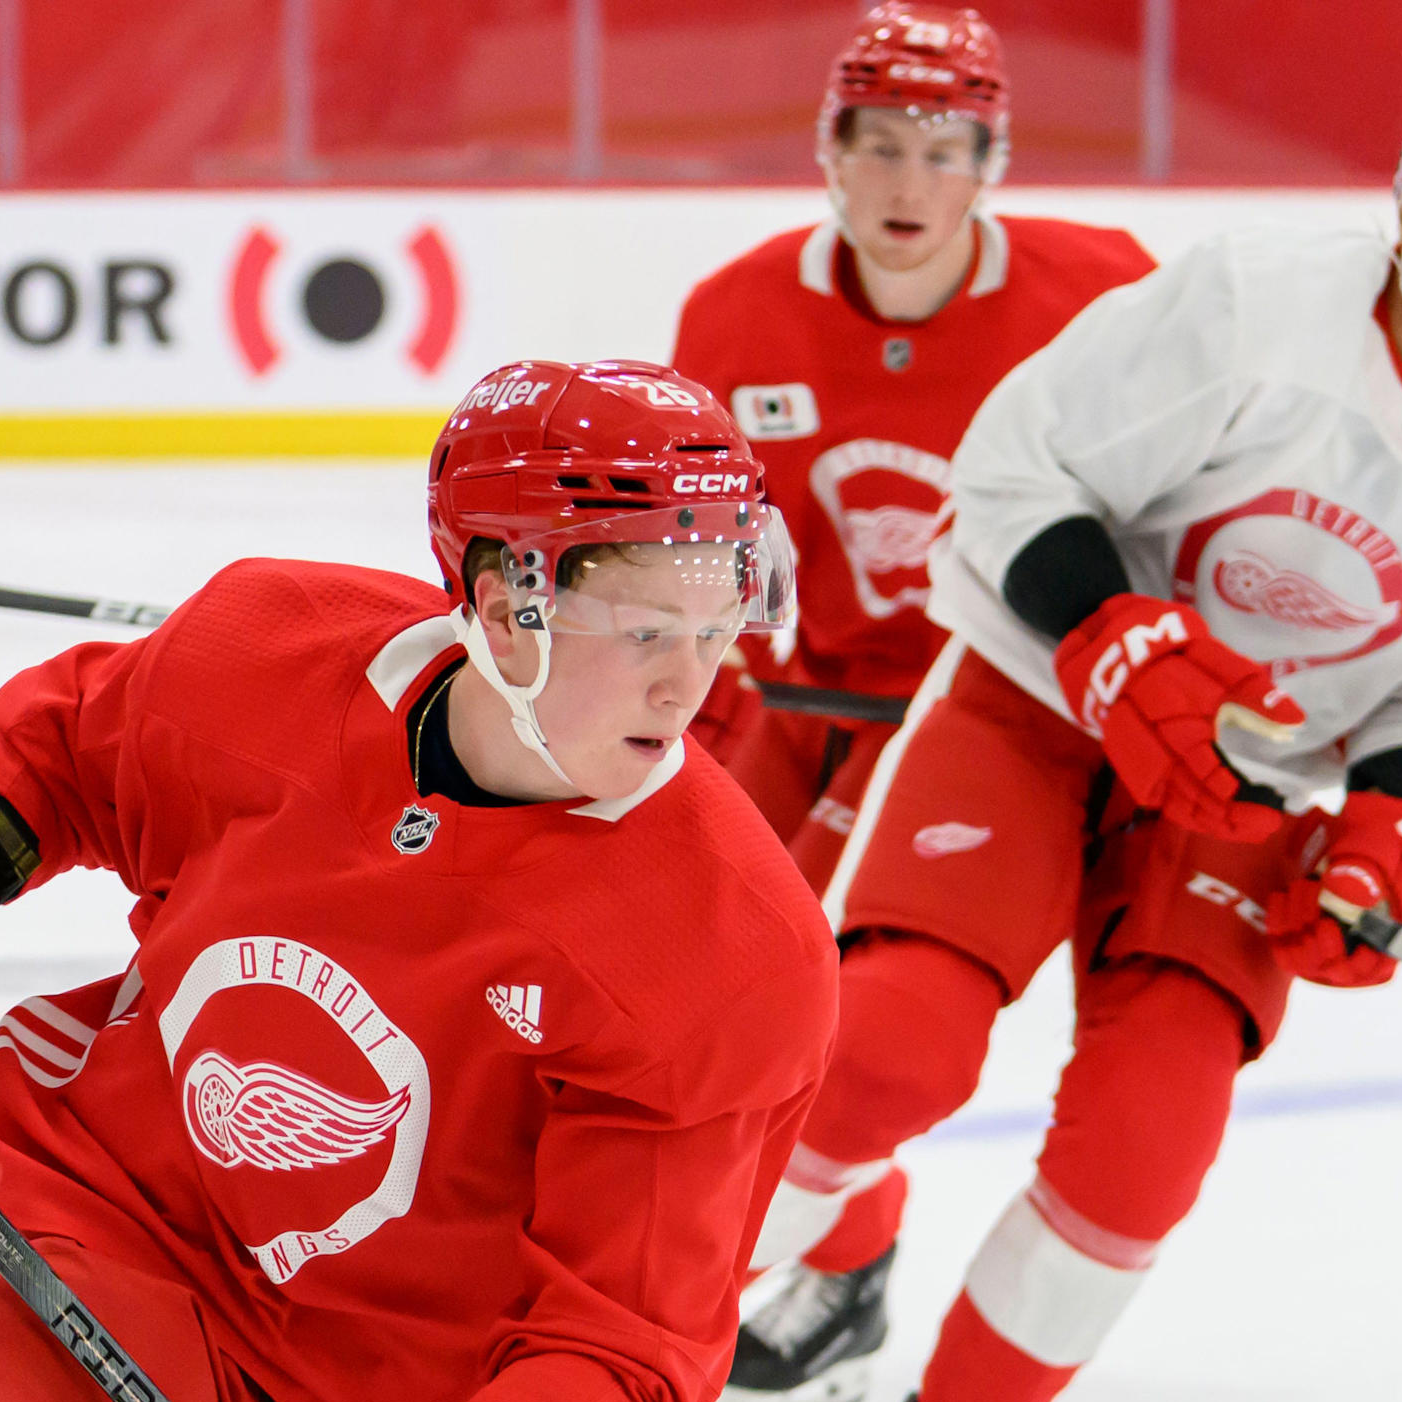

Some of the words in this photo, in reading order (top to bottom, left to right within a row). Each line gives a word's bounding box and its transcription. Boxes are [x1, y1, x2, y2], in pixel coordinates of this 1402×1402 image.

[628, 381, 699, 407] 26
[673, 473, 749, 494] CCM
[1292, 490, 1402, 569] DETROIT
[398, 821, 429, 842] NHL
[238, 940, 399, 1053] DETROIT
[485, 986, 543, 1045] adidas
